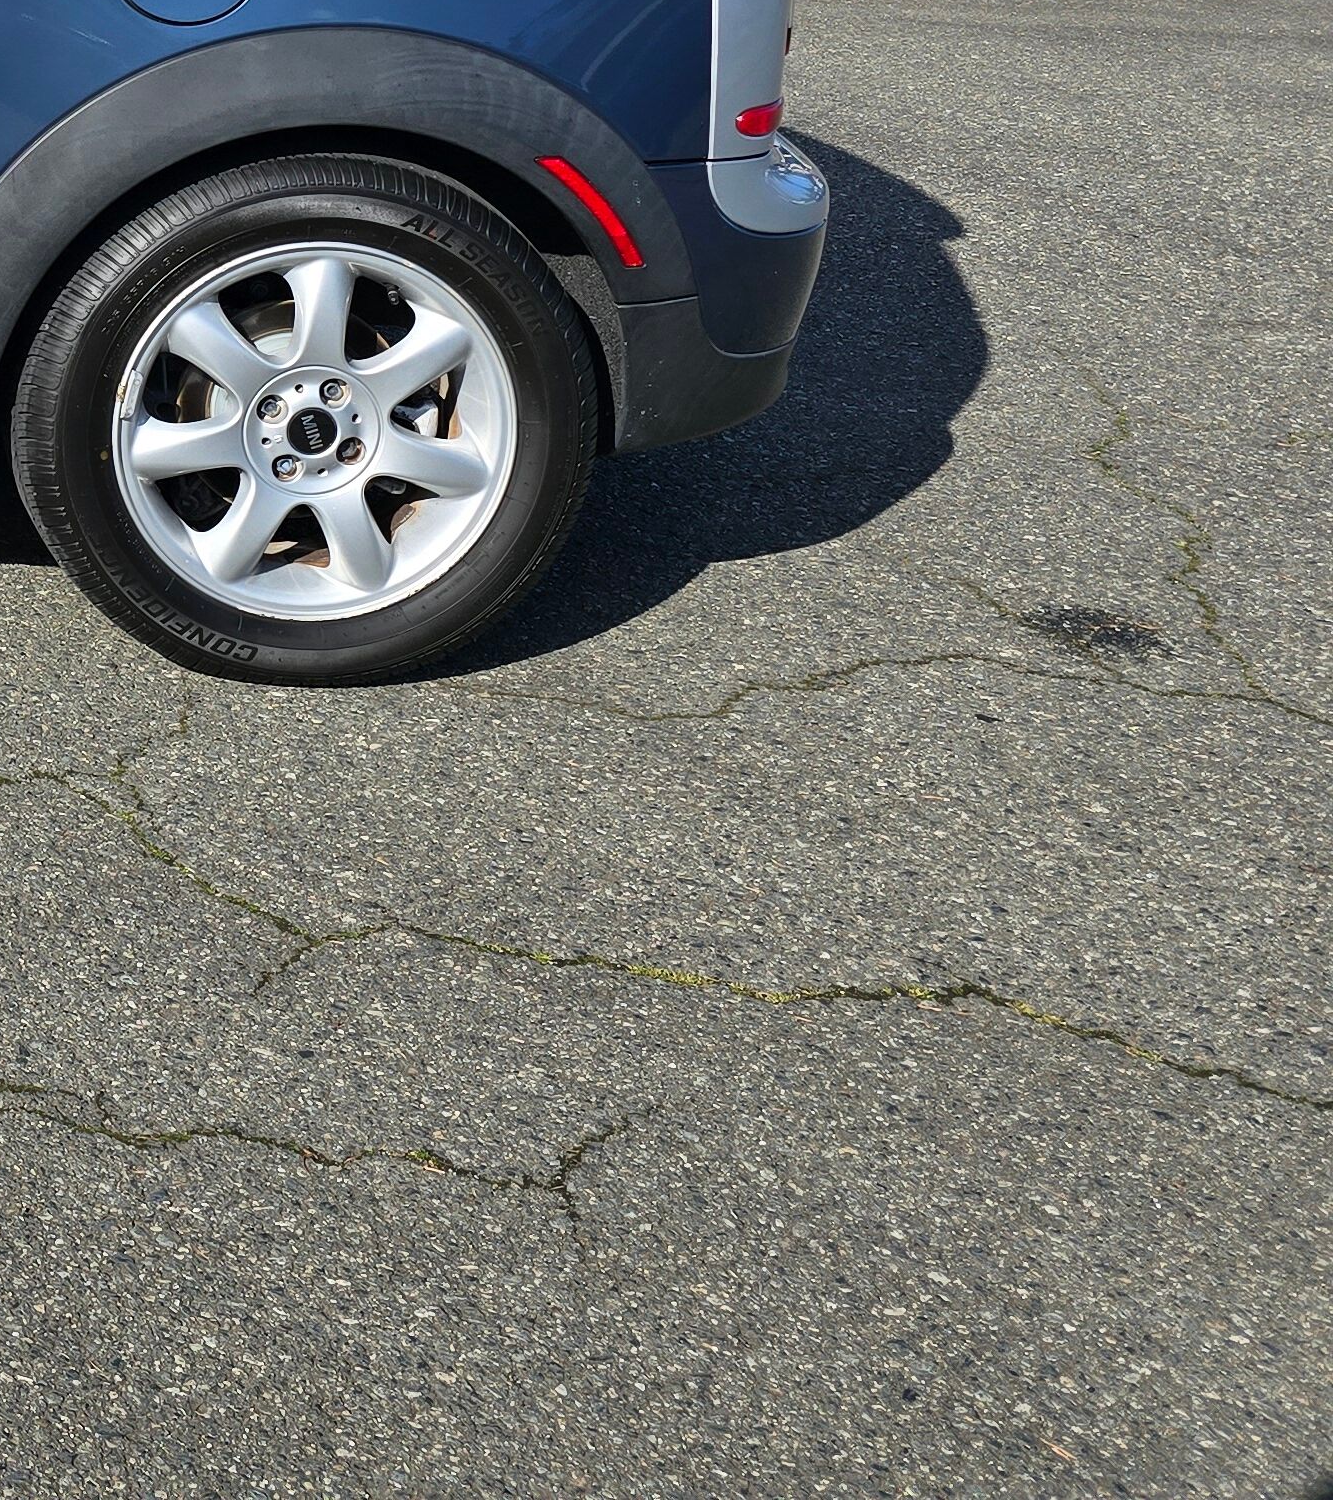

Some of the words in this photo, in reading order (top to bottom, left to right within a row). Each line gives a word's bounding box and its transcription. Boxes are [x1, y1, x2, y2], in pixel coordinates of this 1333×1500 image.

[400, 214, 454, 249] ALL
[458, 243, 546, 336] SEASON
[300, 414, 324, 450] MINI
